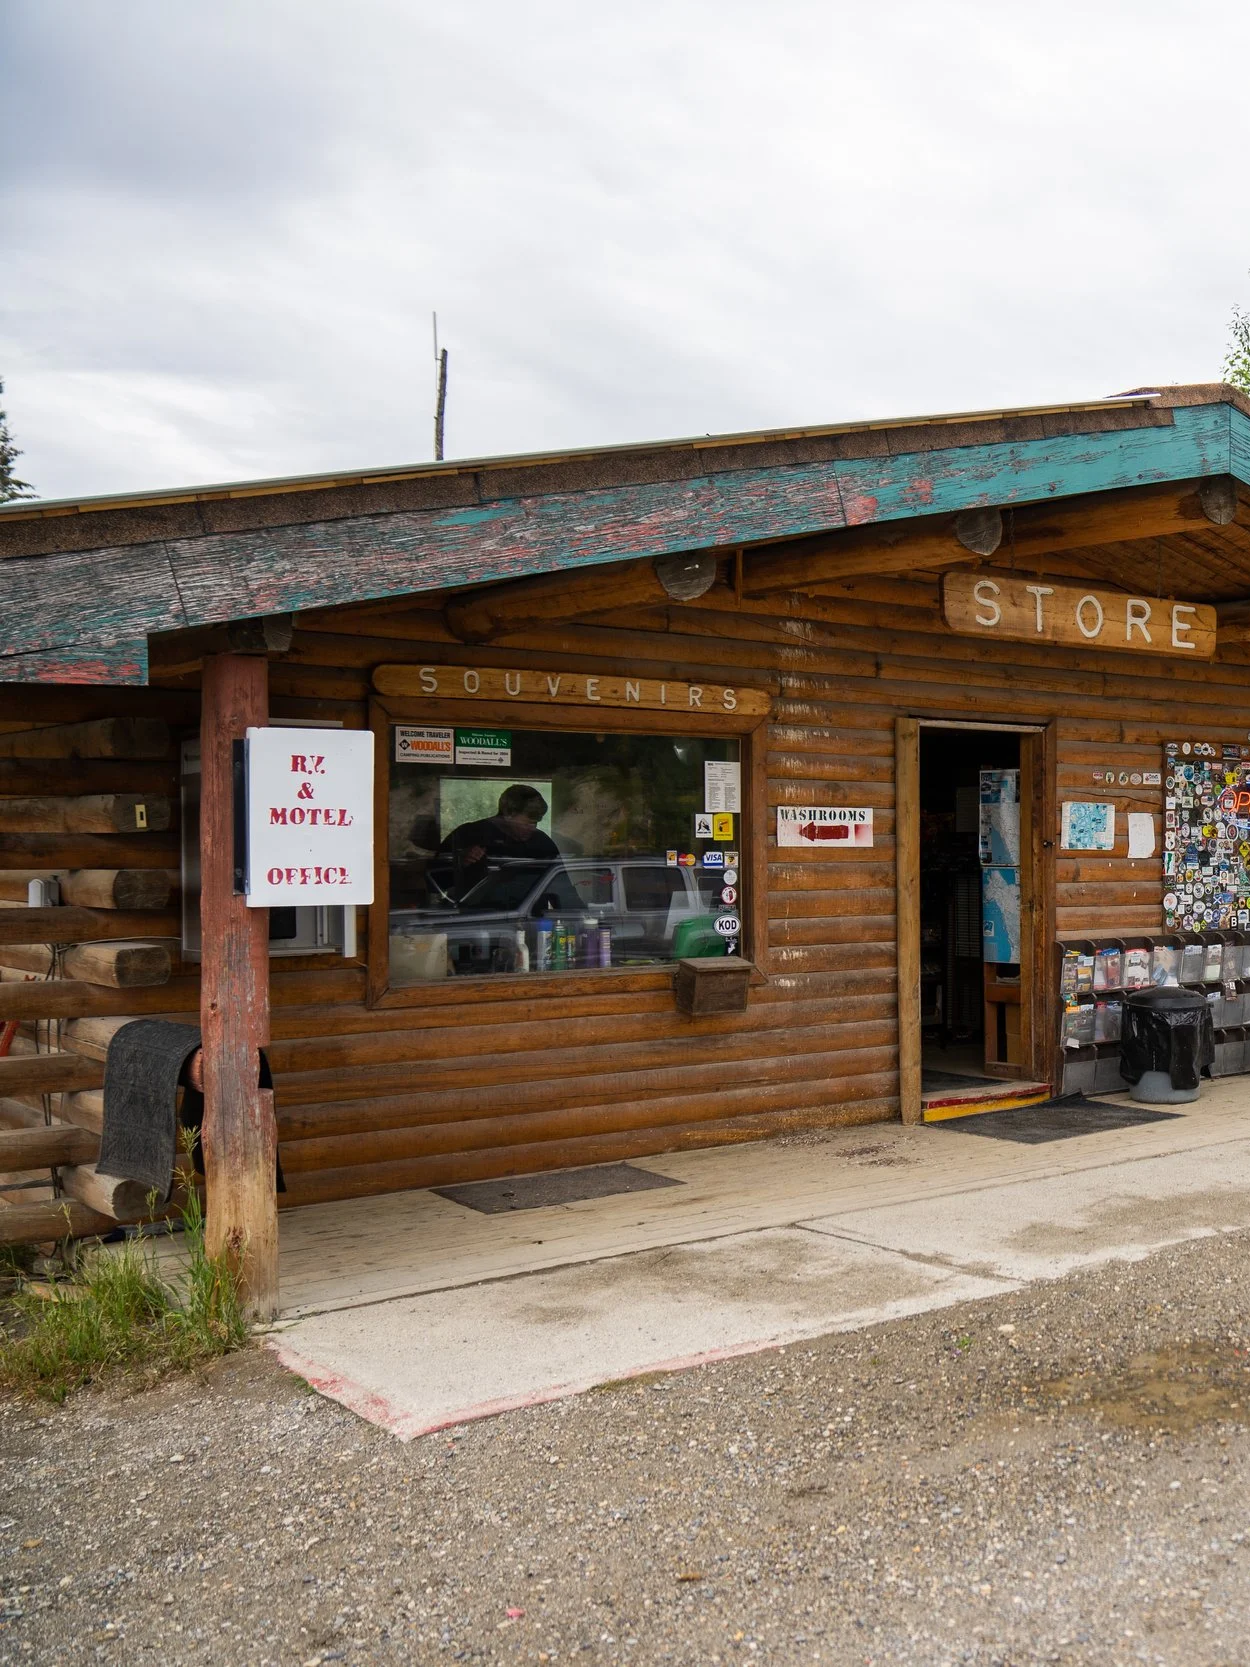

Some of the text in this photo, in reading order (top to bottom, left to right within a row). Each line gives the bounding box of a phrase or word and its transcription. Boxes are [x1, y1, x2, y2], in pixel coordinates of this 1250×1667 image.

[973, 579, 1196, 649] STORE
[418, 667, 738, 710] SOUVENIRS
[426, 731, 451, 739] TRAVELER
[459, 736, 508, 746] WOODALL'S
[410, 740, 451, 751] WOODALL'S
[297, 781, 314, 800] &
[269, 807, 354, 827] MOTEL
[780, 808, 866, 822] WASHROOMS
[267, 866, 353, 885] OFFICE
[718, 919, 737, 930] KOD
[1231, 916, 1238, 927] B
